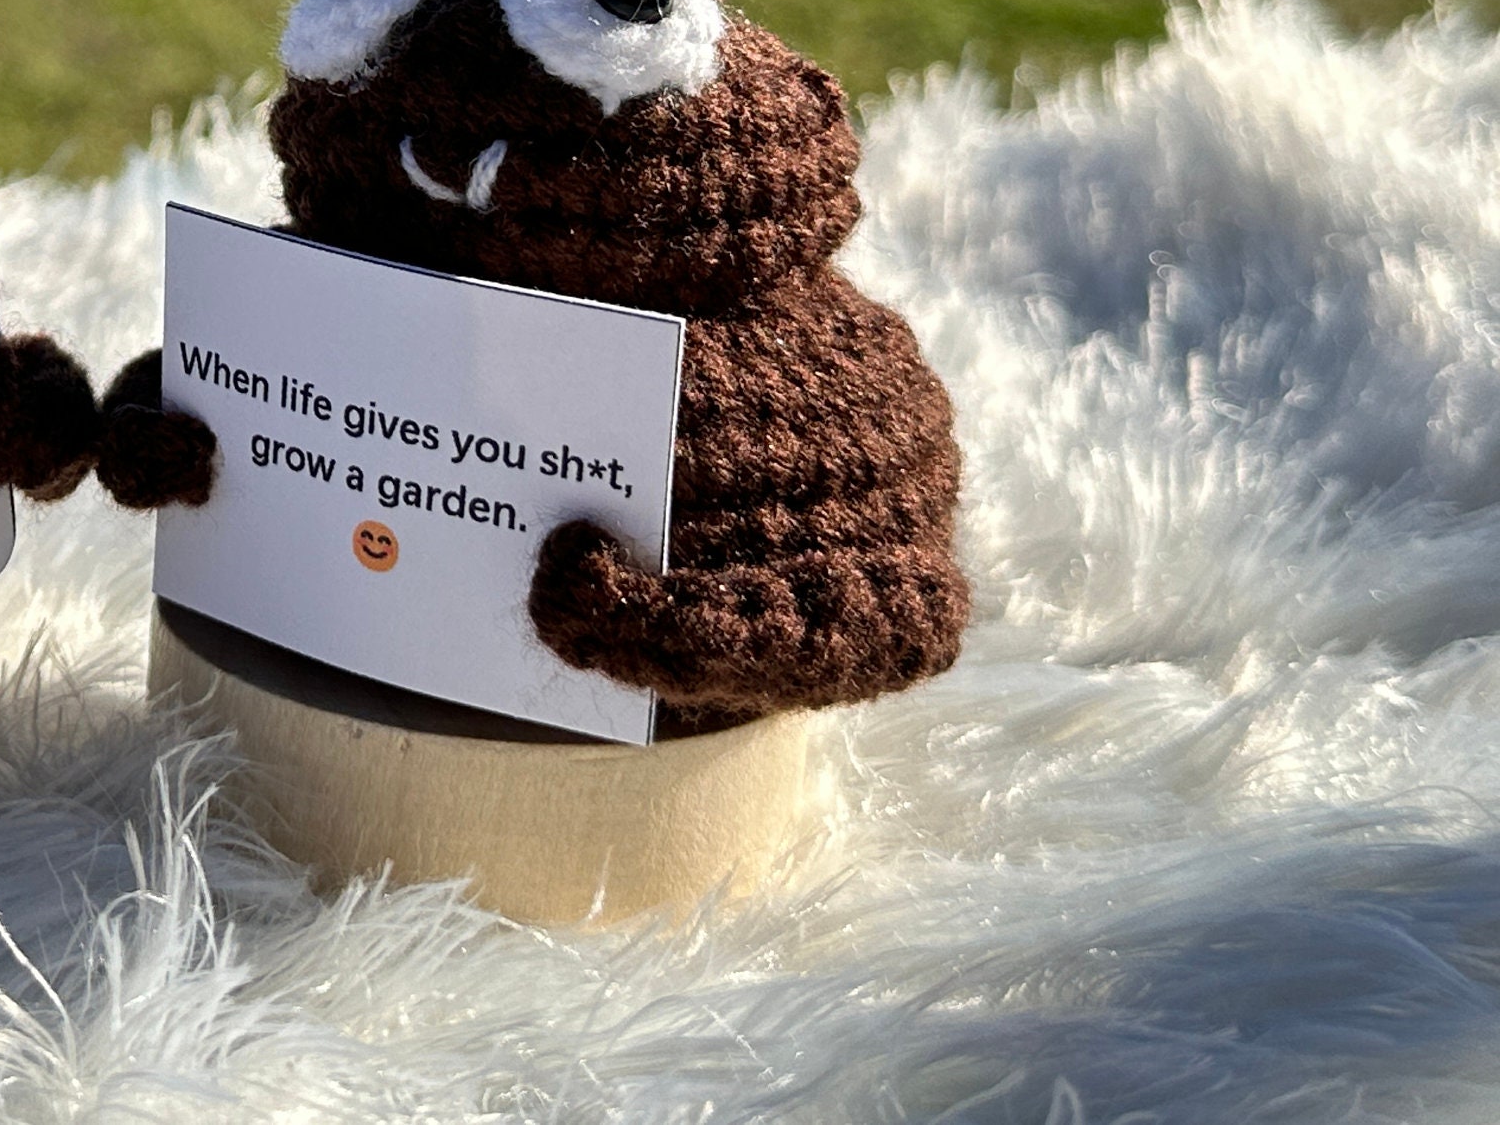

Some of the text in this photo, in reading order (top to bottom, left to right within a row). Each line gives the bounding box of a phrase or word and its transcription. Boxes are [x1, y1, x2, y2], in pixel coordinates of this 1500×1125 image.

[179, 341, 270, 403] When
[281, 375, 333, 421] life
[343, 401, 440, 450] gives
[450, 429, 526, 471] you
[251, 433, 528, 533] grow a garden.
